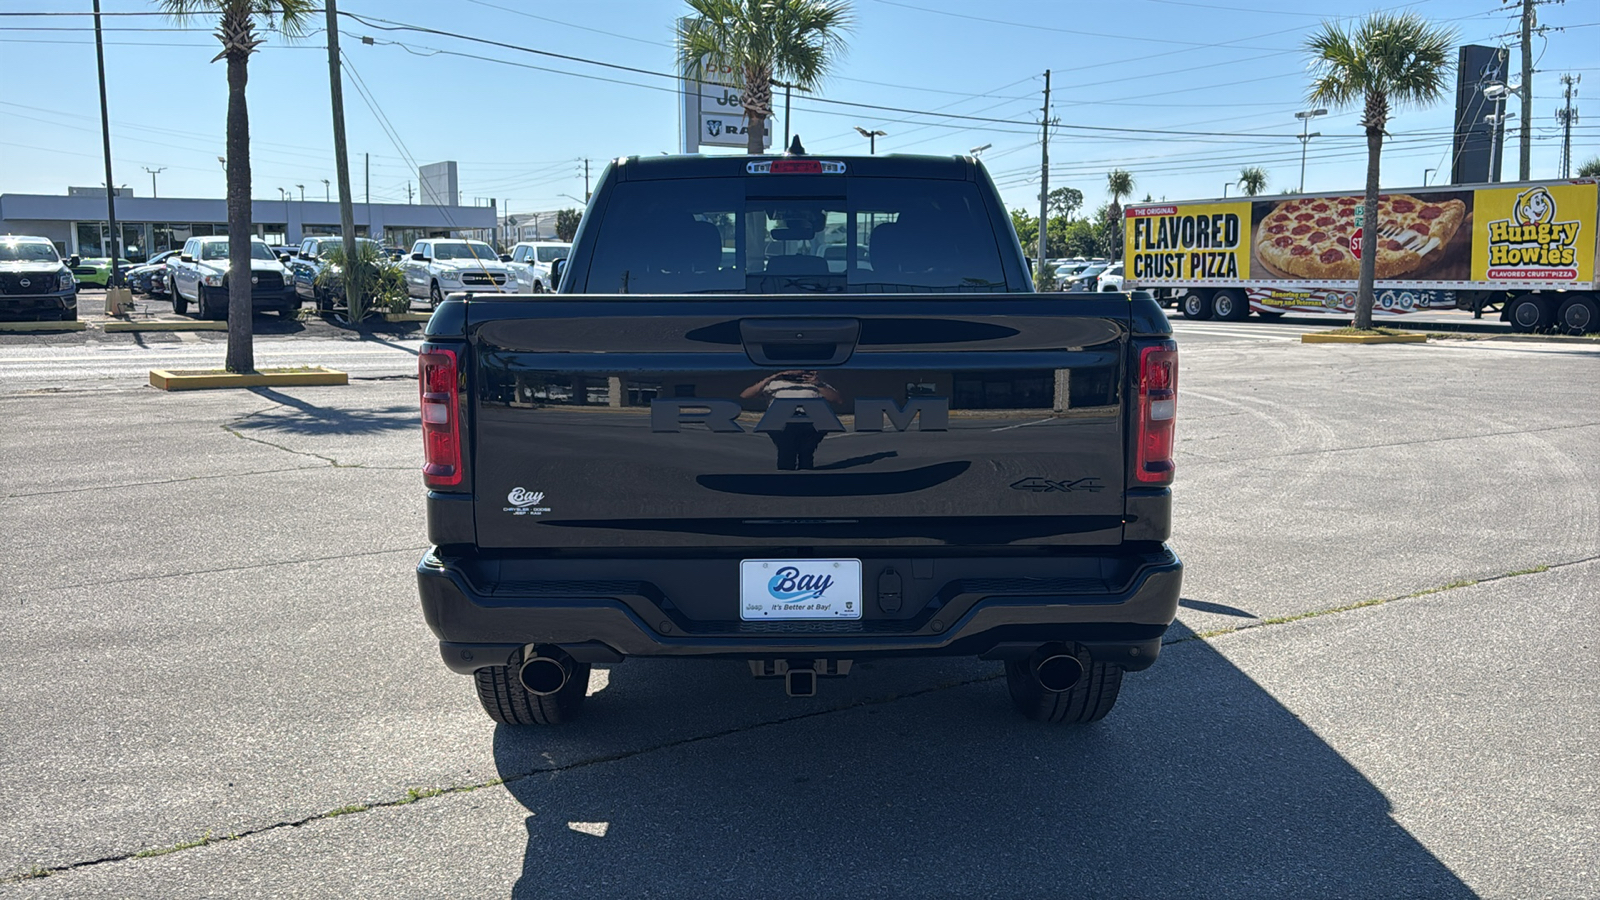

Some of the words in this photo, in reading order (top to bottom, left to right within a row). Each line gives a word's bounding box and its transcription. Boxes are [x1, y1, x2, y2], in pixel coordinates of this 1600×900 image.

[716, 89, 744, 107] Je
[1147, 207, 1175, 215] ORIGINAL
[1134, 213, 1240, 251] FLAVORED
[1490, 221, 1579, 245] Hungry
[1352, 237, 1363, 250] ST
[1134, 252, 1186, 278] CRUST
[1190, 252, 1238, 278] PIZZA
[1490, 244, 1575, 267] Howie's
[1261, 298, 1284, 307] Military
[1296, 299, 1322, 307] Veterans
[650, 397, 949, 433] RAM
[510, 486, 545, 507] Bay
[772, 566, 834, 599] Bay
[815, 604, 831, 612] Bay!
